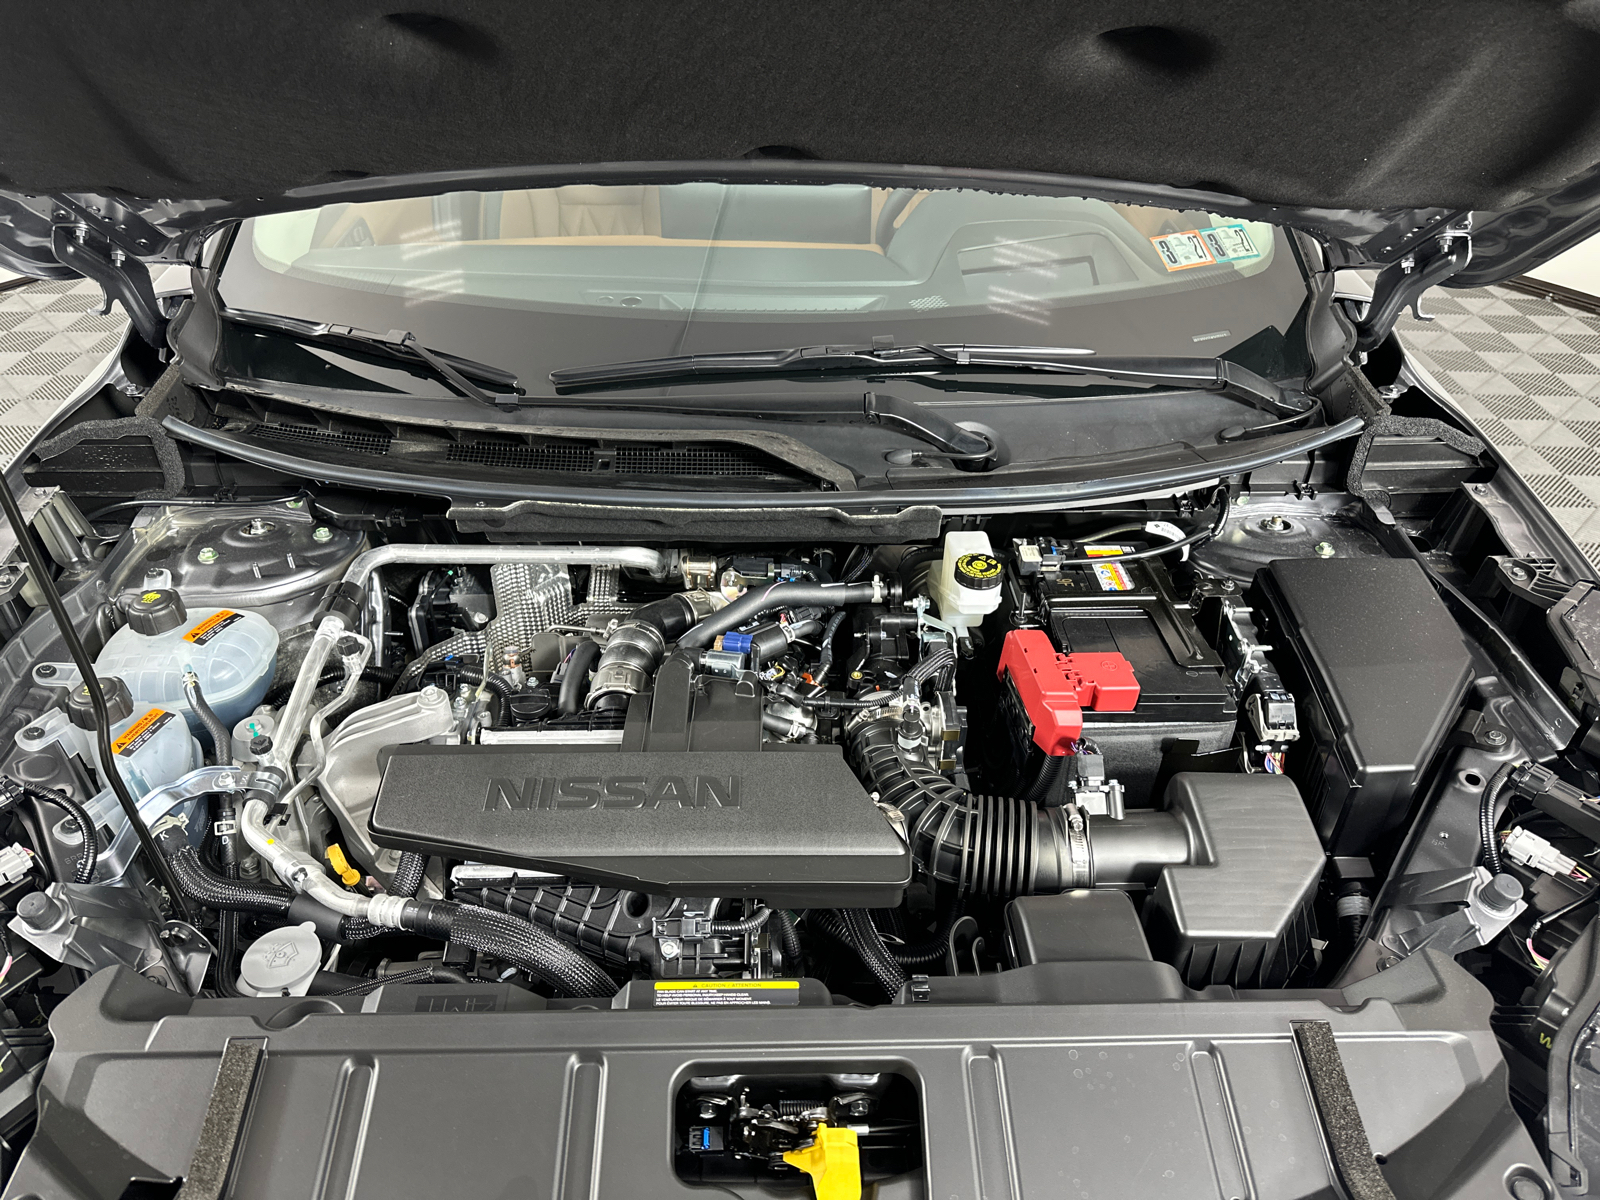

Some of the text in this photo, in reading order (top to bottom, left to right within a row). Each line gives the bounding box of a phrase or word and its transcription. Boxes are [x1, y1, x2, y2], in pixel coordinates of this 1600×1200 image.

[1158, 240, 1178, 264] 3
[1187, 235, 1207, 259] 27
[1207, 233, 1226, 258] 3
[1234, 229, 1254, 252] 27
[482, 775, 742, 812] NISSAN
